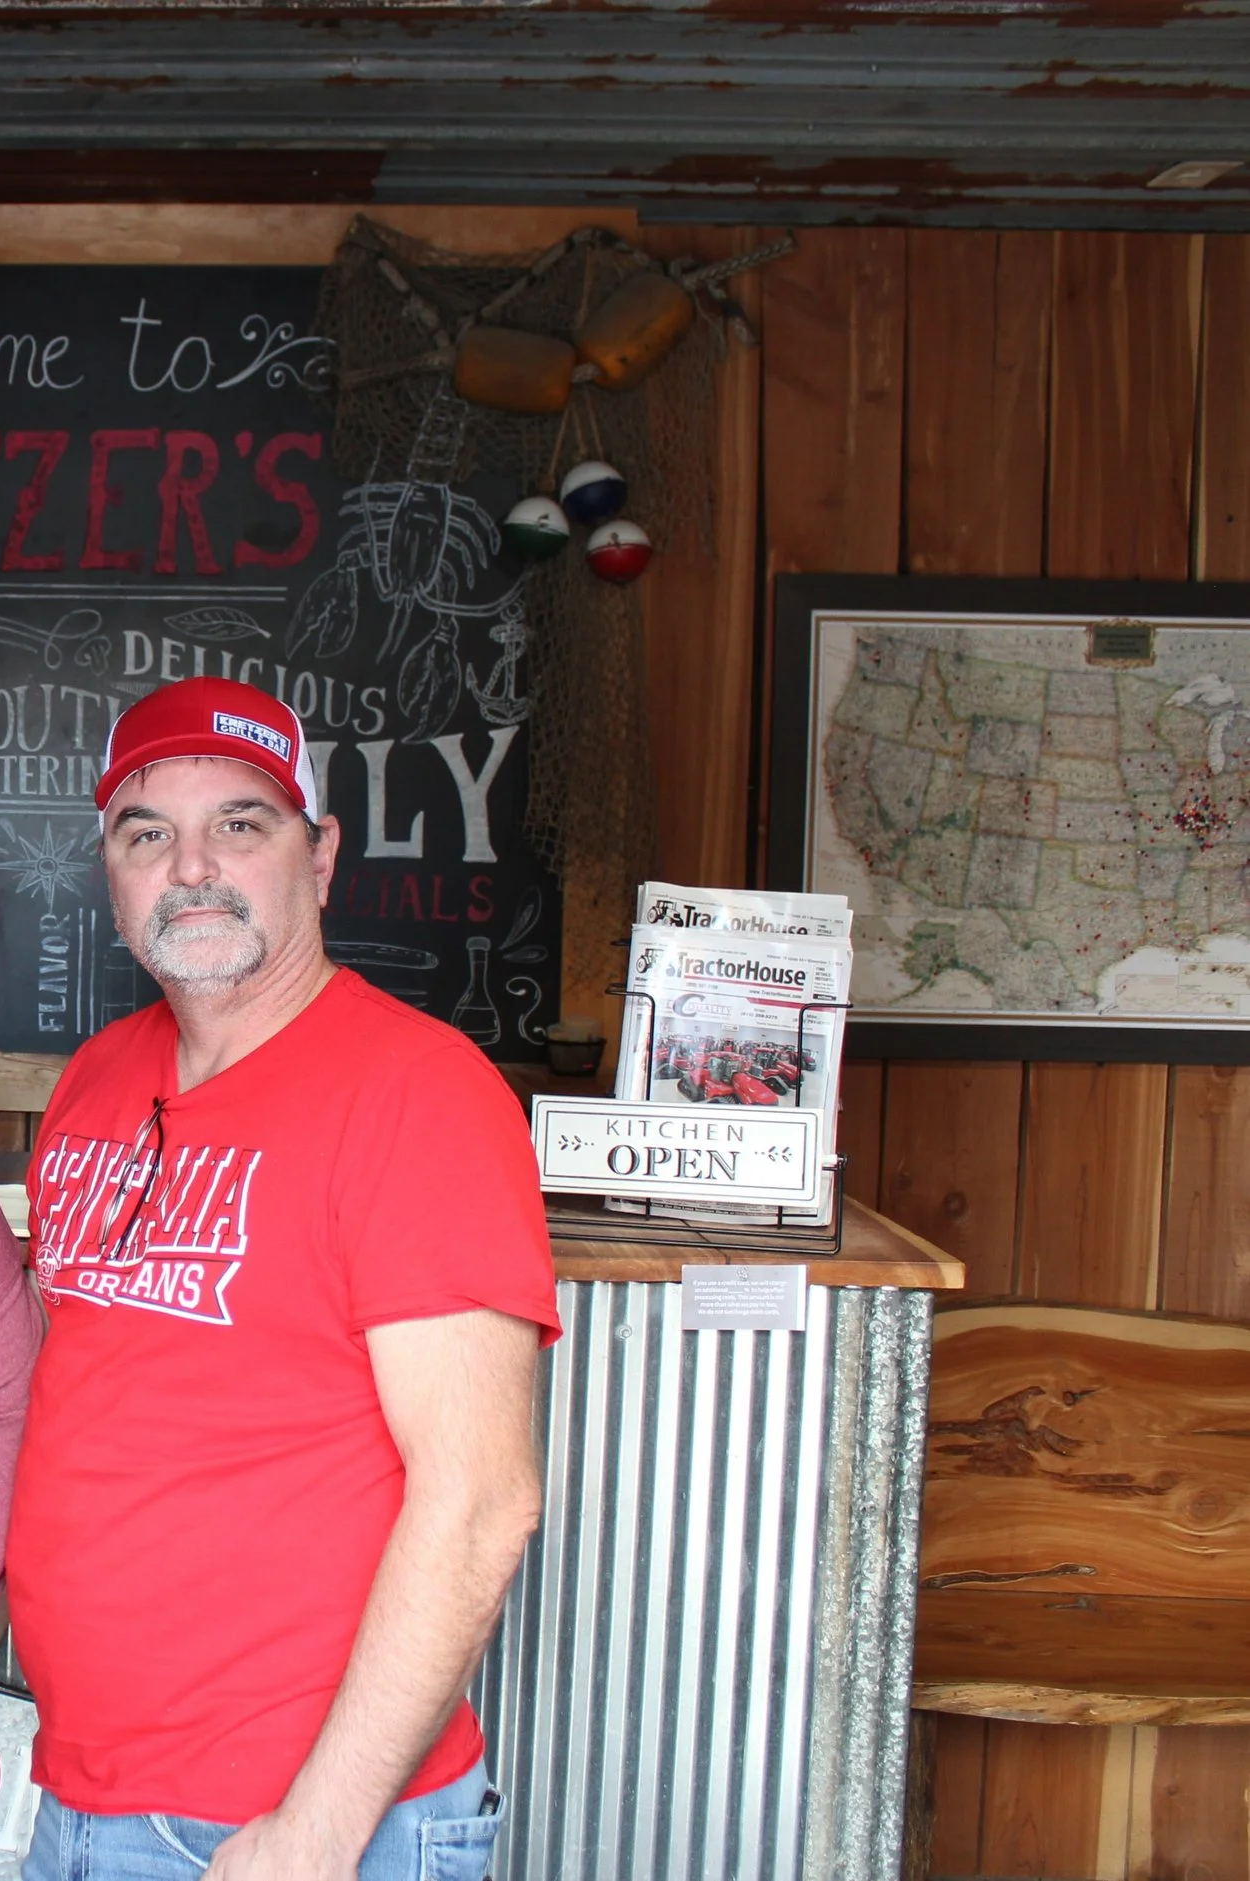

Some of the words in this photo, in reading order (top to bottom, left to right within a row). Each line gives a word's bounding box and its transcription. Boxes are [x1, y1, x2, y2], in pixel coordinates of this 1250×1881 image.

[120, 298, 216, 392] to
[219, 716, 287, 748] KRETZER'S
[220, 725, 254, 739] GRILL
[267, 739, 285, 755] BAR
[37, 912, 71, 1033] FLAVOR
[678, 951, 806, 986] TractorHouse
[606, 1118, 743, 1142] KITCHEN
[607, 1145, 740, 1181] OPEN
[77, 1261, 204, 1309] ORANS
